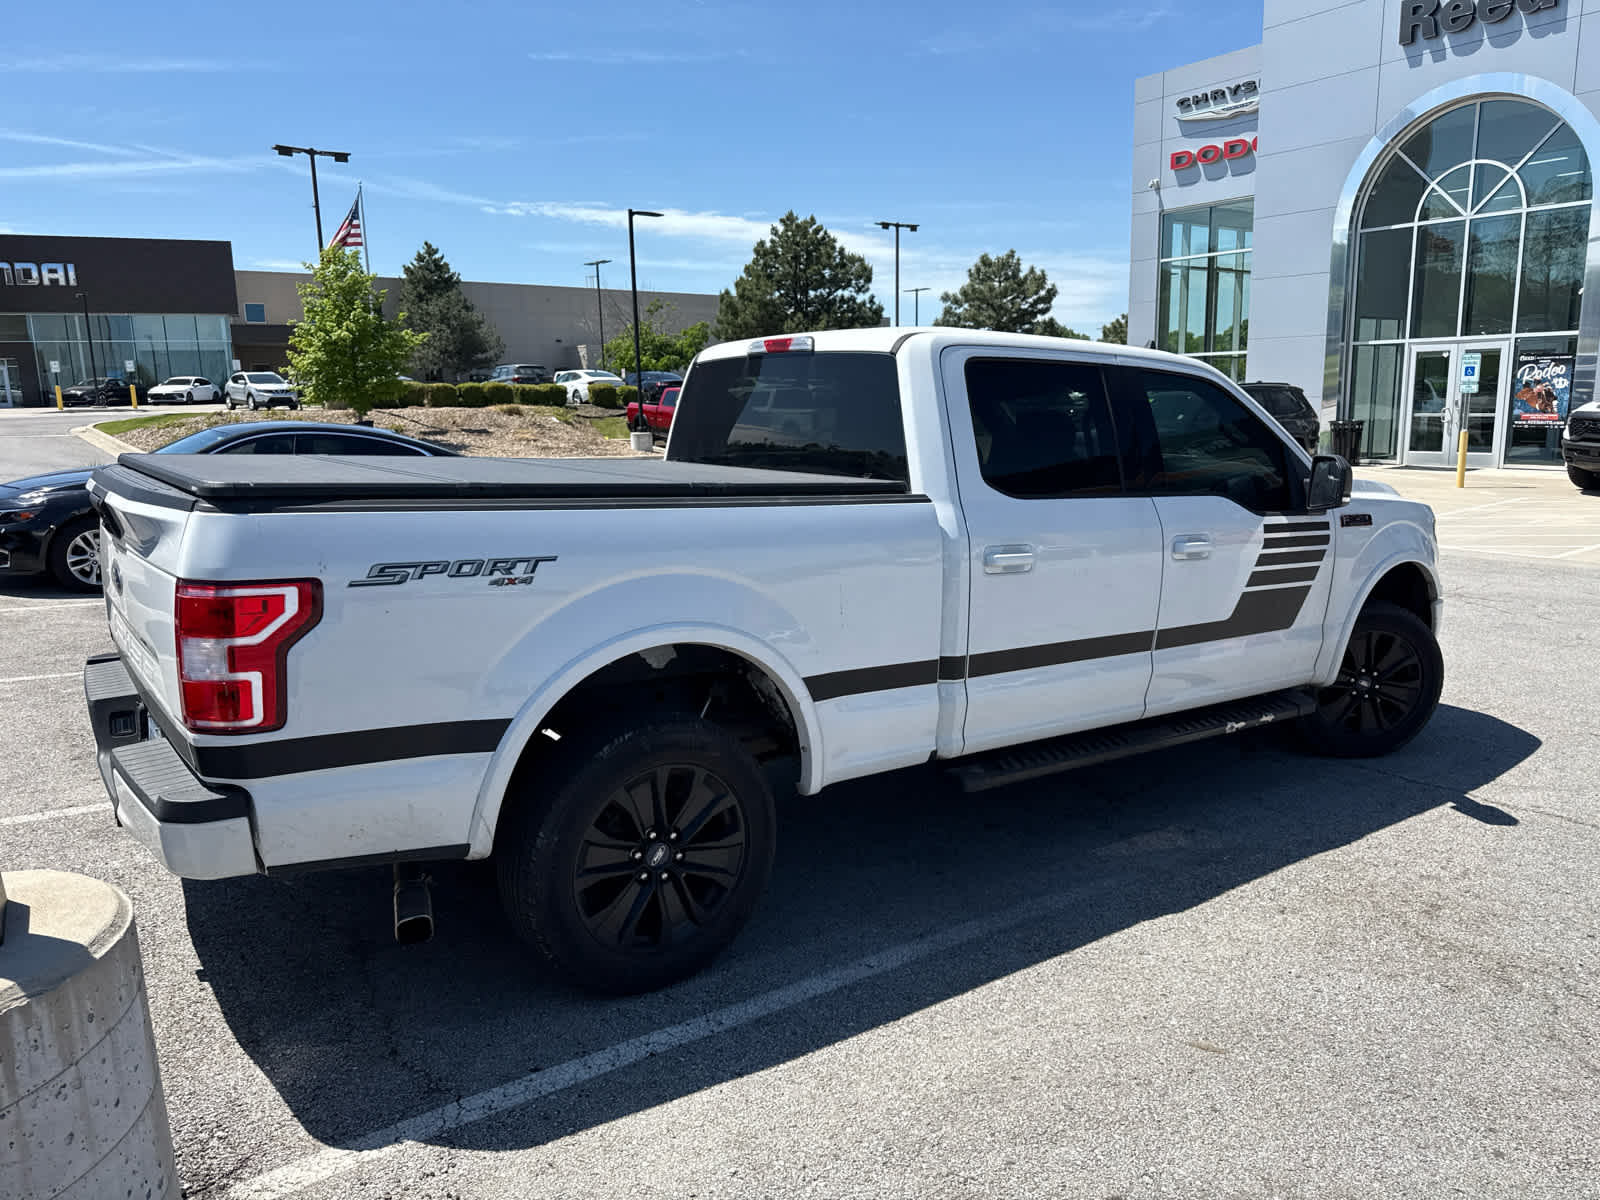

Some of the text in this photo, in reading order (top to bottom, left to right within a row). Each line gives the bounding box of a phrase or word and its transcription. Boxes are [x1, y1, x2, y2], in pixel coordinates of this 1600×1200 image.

[1176, 78, 1261, 108] CHRYS
[1170, 136, 1258, 170] DOD
[1517, 362, 1566, 384] Rodeo
[347, 555, 558, 588] SPORT
